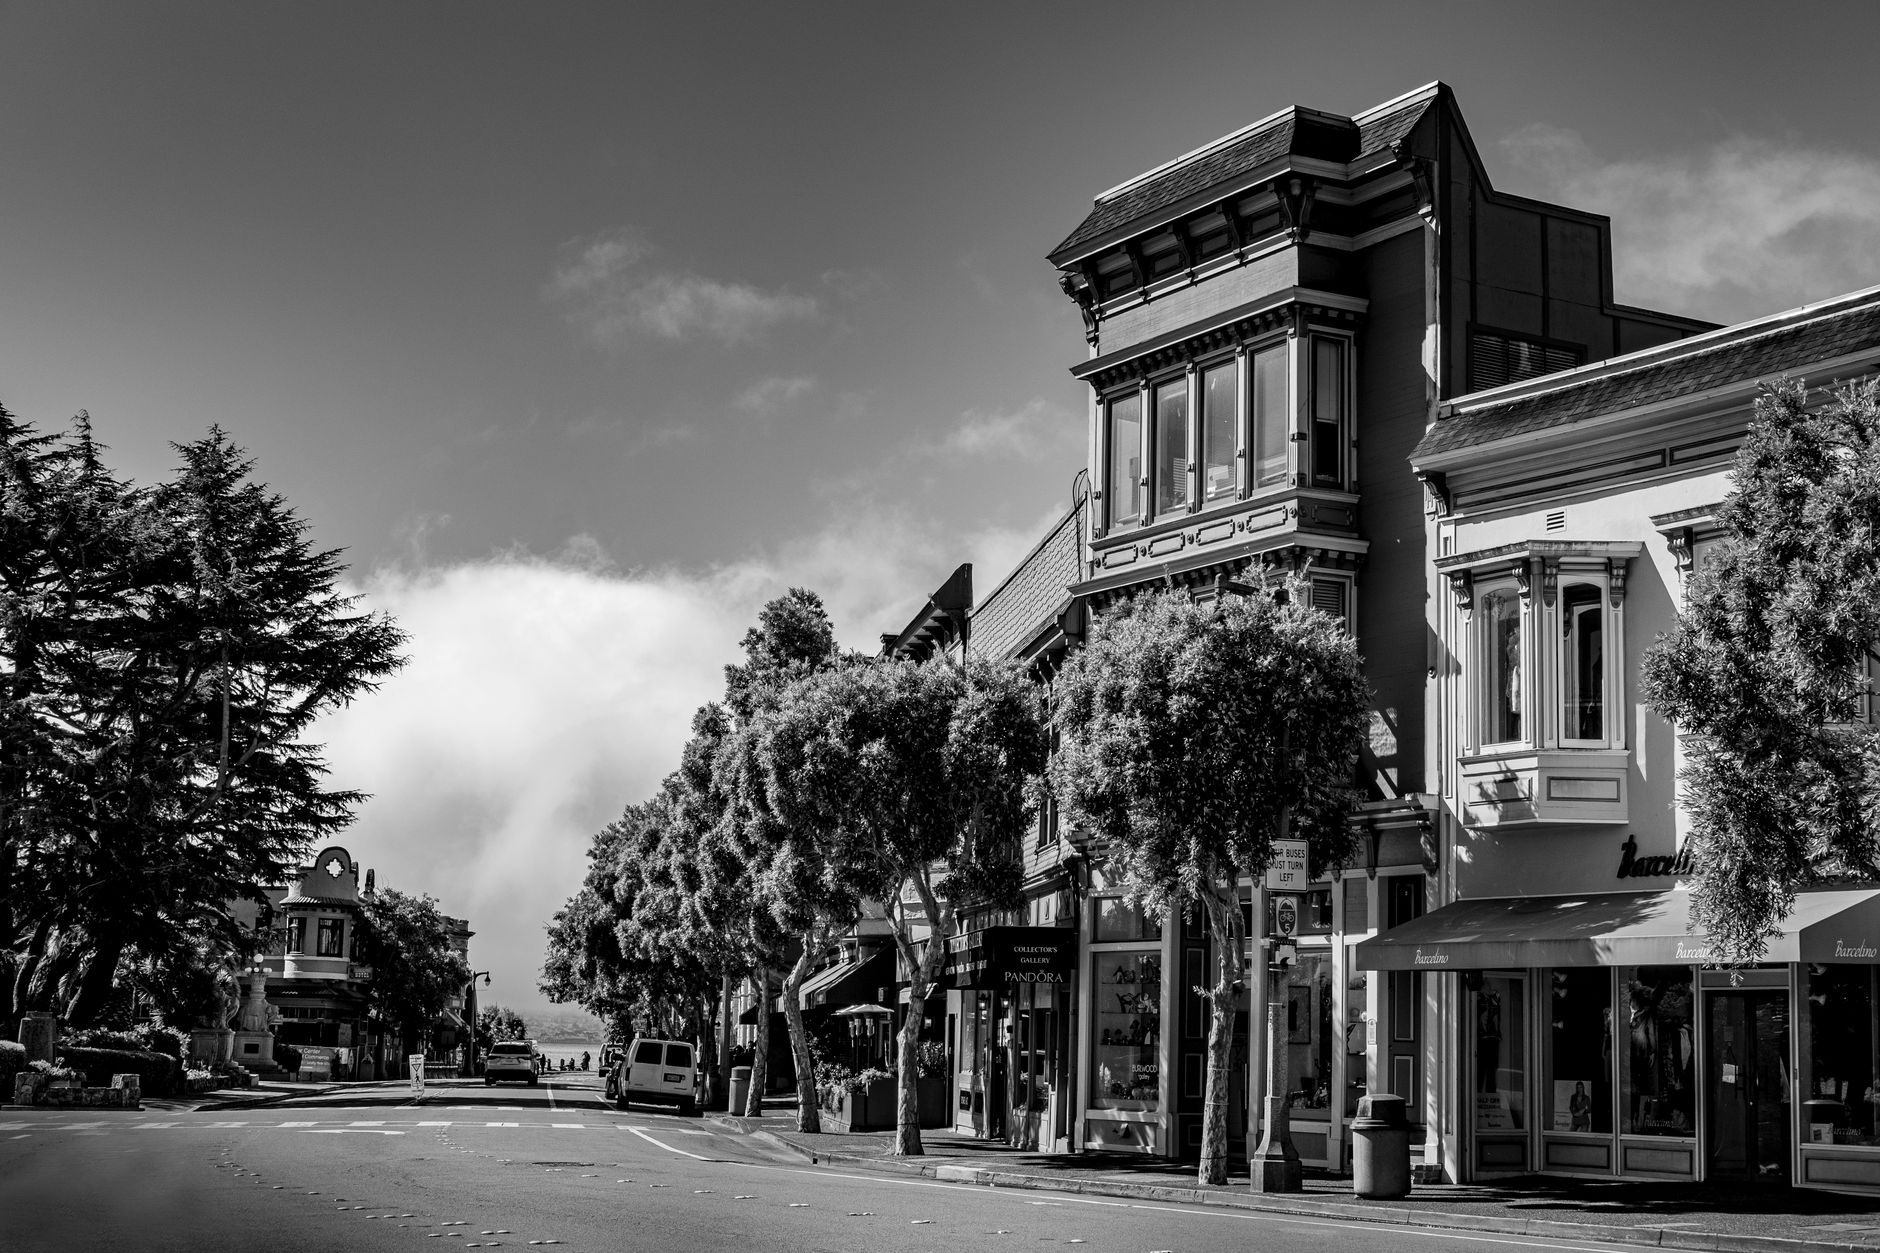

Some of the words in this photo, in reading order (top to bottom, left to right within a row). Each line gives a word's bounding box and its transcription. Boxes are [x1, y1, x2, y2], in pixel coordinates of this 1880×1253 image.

[1286, 848, 1305, 858] BUSES
[1288, 861, 1303, 870] TURN
[1280, 872, 1294, 882] LEFT
[1284, 923, 1291, 934] 5
[1013, 945, 1058, 953] COLLECTOR'S
[1834, 938, 1878, 958] Barcelino
[1020, 956, 1051, 964] GALLERY
[1414, 945, 1449, 965] Barcelino
[1005, 969, 1063, 983] PANDORA
